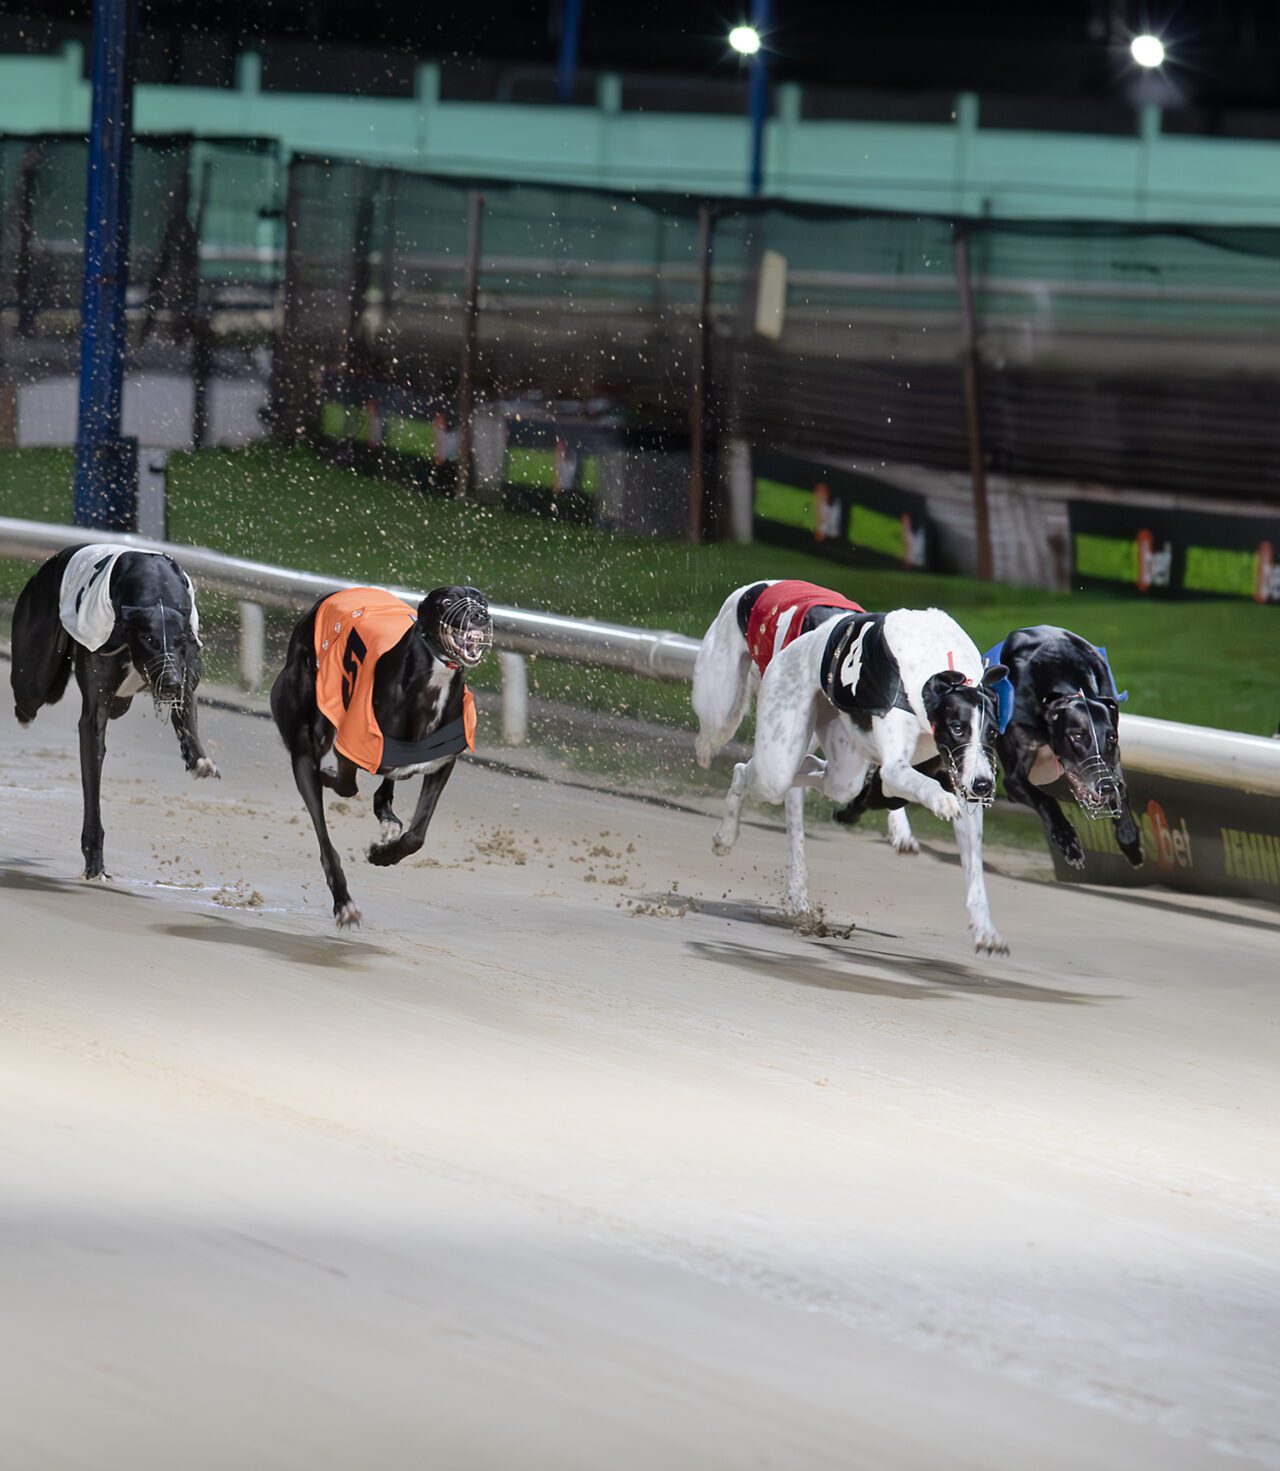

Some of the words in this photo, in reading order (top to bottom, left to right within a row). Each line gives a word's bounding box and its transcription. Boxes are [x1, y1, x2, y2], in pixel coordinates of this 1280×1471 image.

[340, 626, 368, 713] 5
[773, 605, 798, 660] 1
[840, 621, 876, 697] 4
